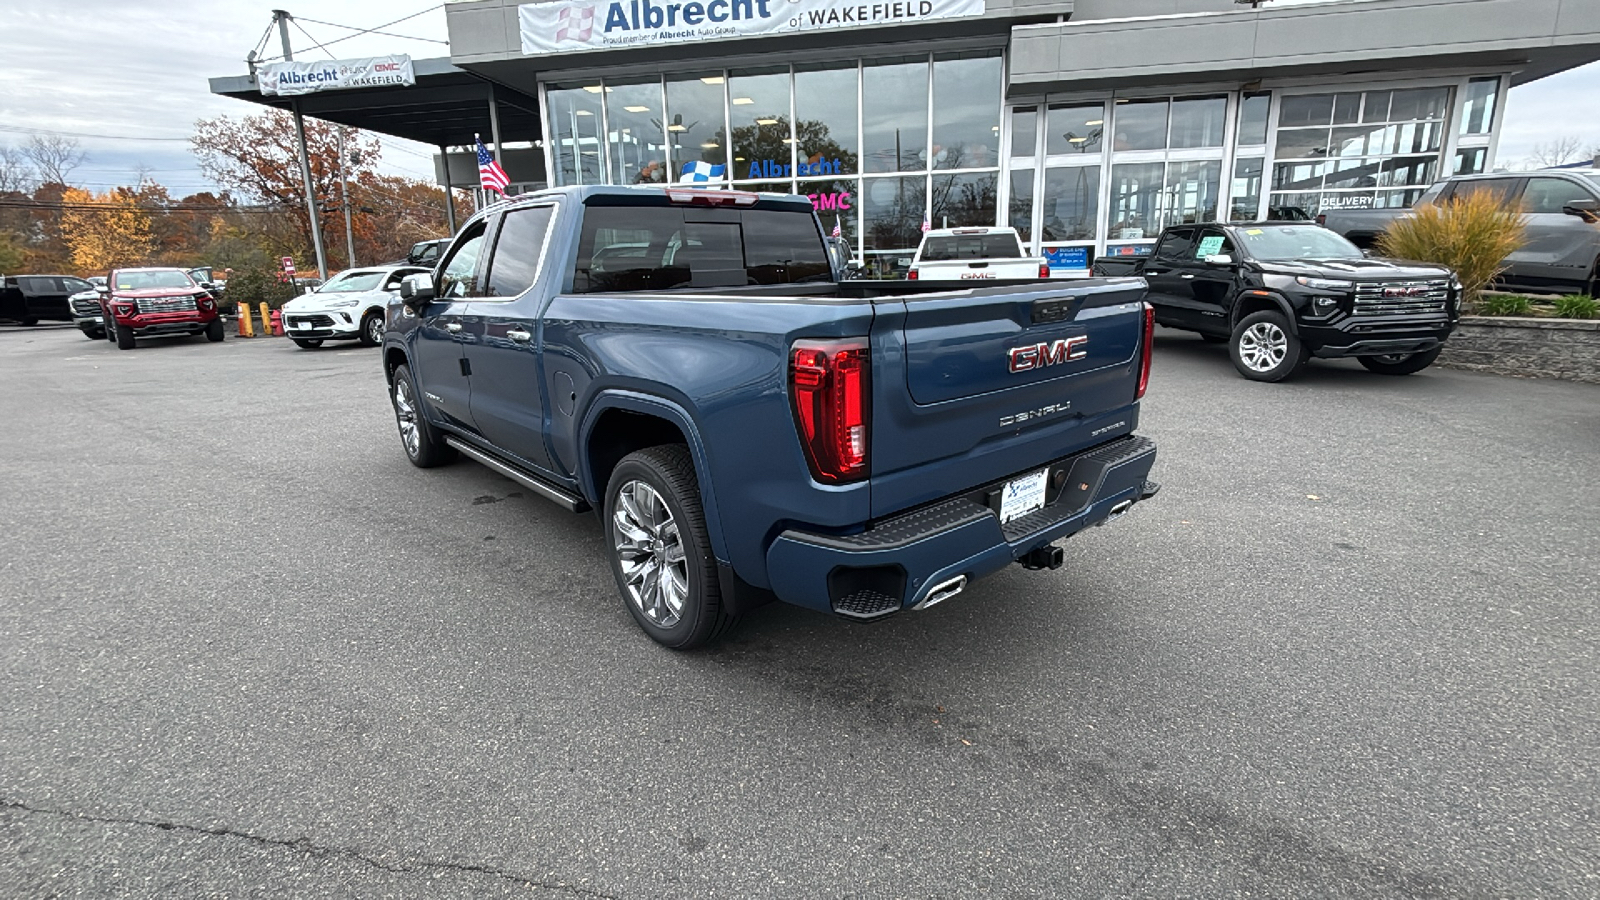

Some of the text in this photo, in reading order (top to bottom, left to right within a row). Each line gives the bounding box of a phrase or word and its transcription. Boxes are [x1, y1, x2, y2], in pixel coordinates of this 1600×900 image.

[604, 0, 771, 33] Albrecht
[789, 1, 932, 27] of WAKEFIELD
[603, 36, 622, 44] Proud
[623, 34, 650, 43] member
[650, 31, 658, 40] of
[659, 29, 695, 39] Albrecht
[714, 26, 736, 35] Group
[279, 69, 338, 84] Albrecht
[375, 63, 400, 72] GMC
[352, 75, 402, 86] WAKEFIELD
[748, 157, 841, 178] Albrecht
[808, 192, 850, 211] GMC
[1322, 196, 1373, 206] DELIVERY
[1007, 335, 1088, 373] GMC
[1000, 401, 1071, 427] DENALI
